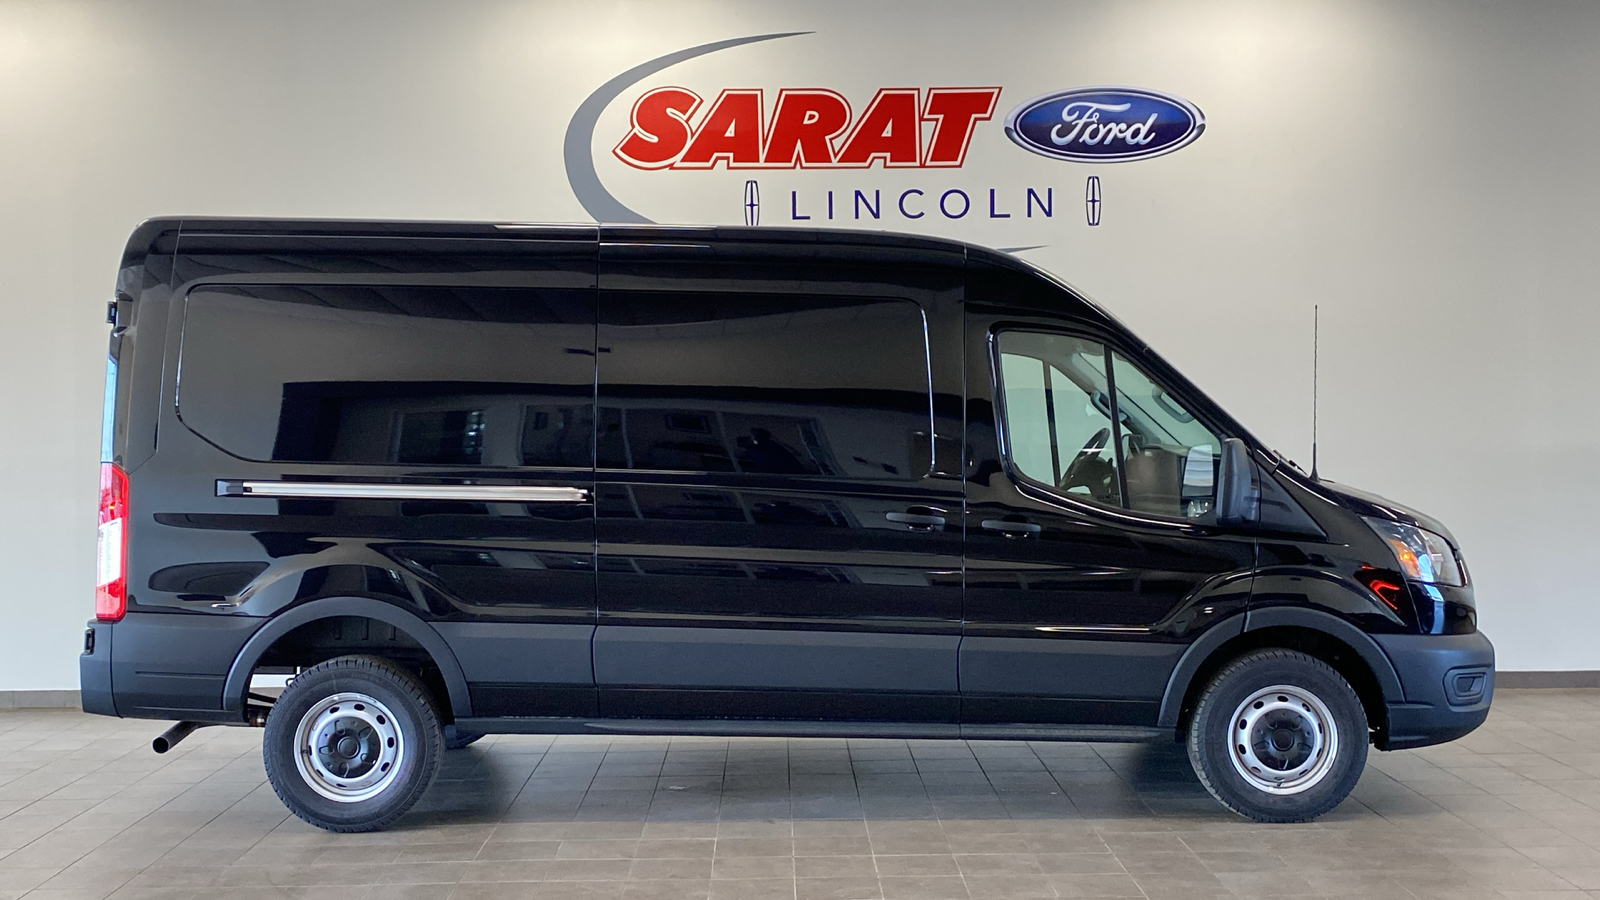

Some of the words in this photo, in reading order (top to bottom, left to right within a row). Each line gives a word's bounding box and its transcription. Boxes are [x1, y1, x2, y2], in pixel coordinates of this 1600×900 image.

[612, 86, 1002, 170] SARAT
[1050, 102, 1156, 146] Ford
[791, 187, 1053, 220] LINCOLN
